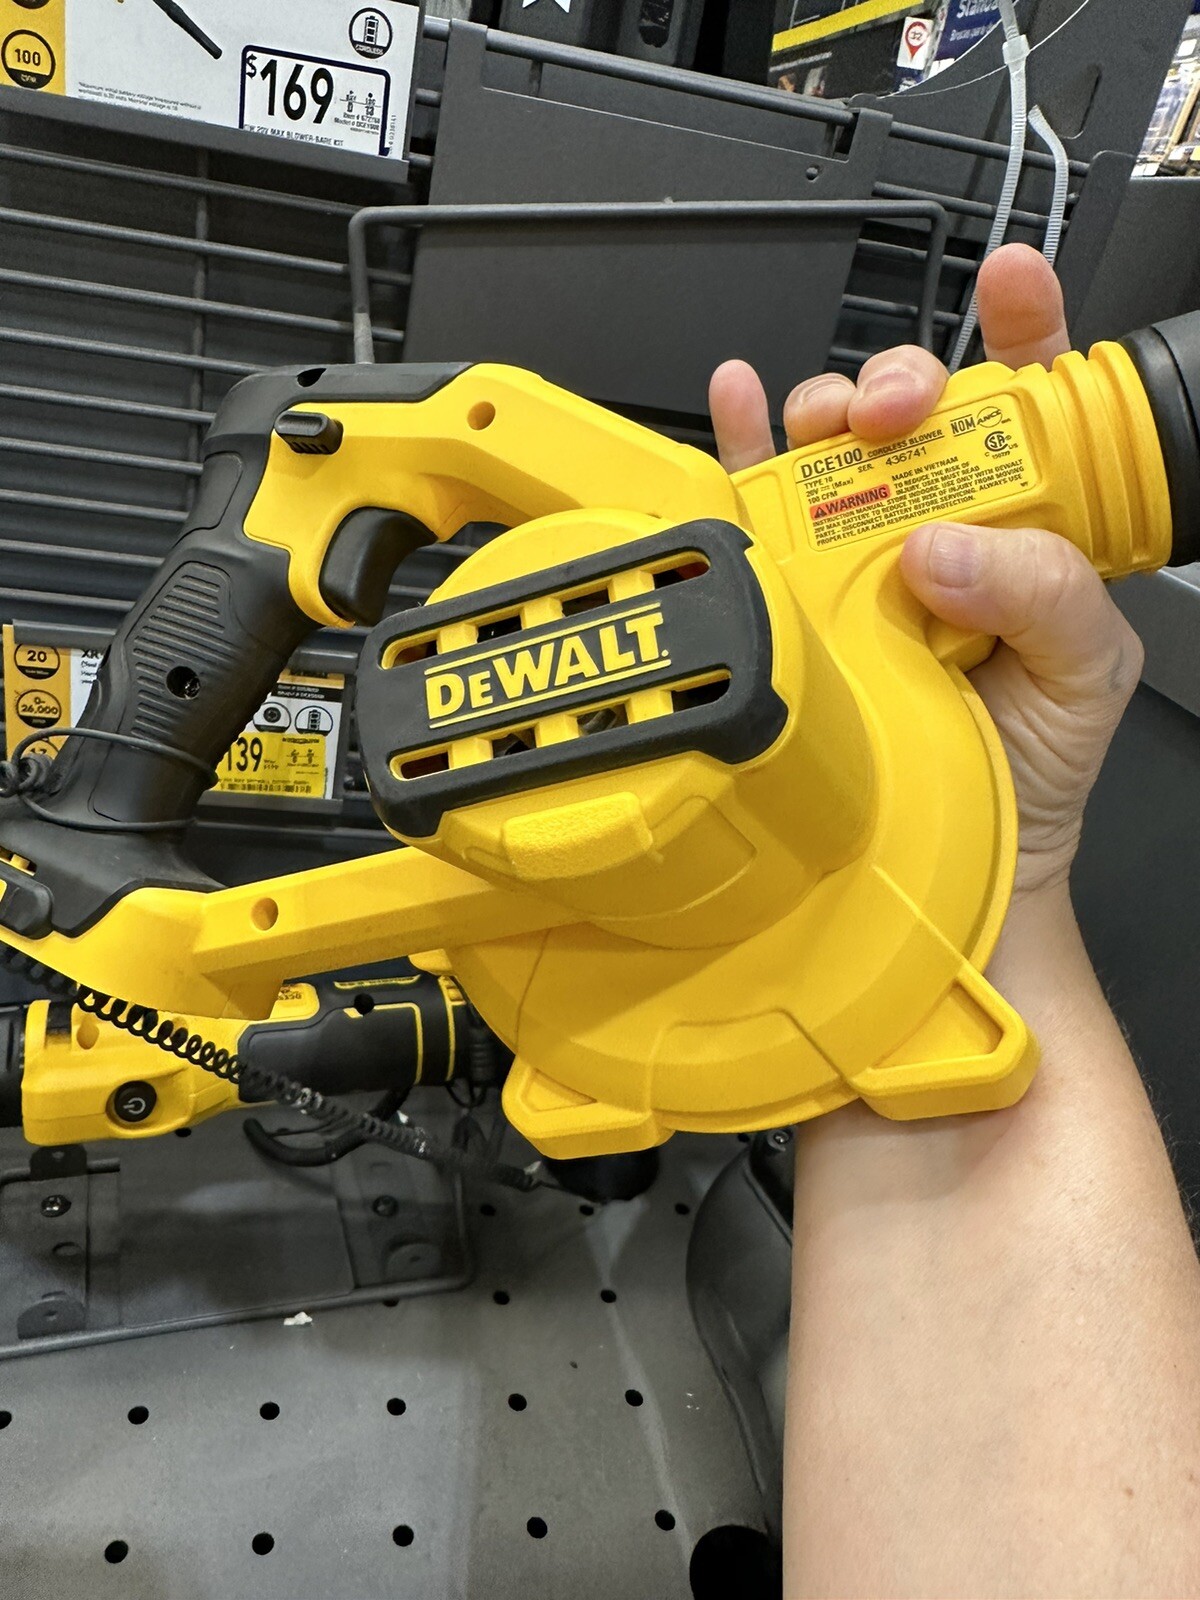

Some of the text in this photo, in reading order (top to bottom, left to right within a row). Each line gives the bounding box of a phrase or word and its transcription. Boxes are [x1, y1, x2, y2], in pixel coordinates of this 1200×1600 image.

[14, 48, 41, 66] 100
[950, 417, 975, 434] NOM
[801, 429, 943, 478] DCE100 CORDLESS BLOWER
[885, 446, 927, 467] 436741
[892, 470, 914, 481] MADE
[924, 456, 958, 471] VIETNAM
[931, 470, 944, 478] THE
[941, 472, 961, 482] MUST
[962, 466, 980, 475] READ
[974, 475, 995, 485] FROM
[996, 466, 1024, 479] MOVING
[1008, 473, 1022, 481] USE
[805, 479, 824, 490] TYPE
[813, 511, 855, 528] INSTRUCTION
[942, 480, 955, 488] USE
[956, 475, 974, 484] ONLY
[975, 469, 994, 478] WITH
[826, 486, 889, 515] WARNING
[871, 522, 886, 531] AND
[27, 650, 48, 663] 20
[21, 704, 59, 715] 26,000
